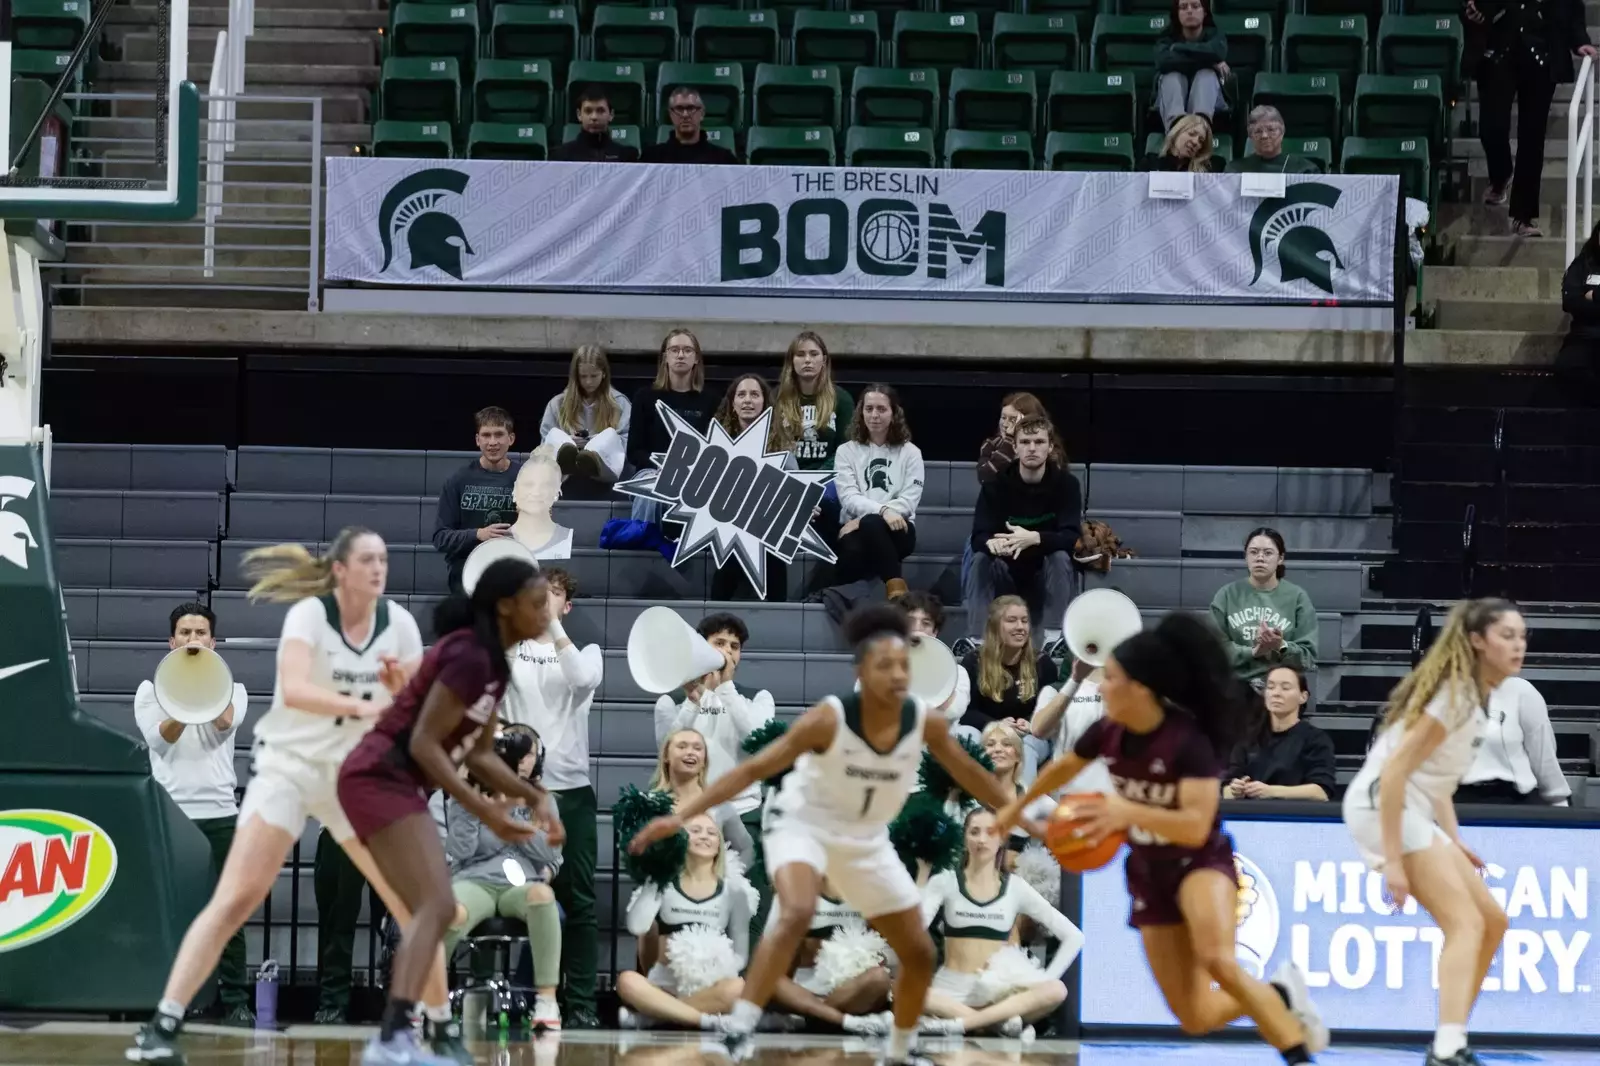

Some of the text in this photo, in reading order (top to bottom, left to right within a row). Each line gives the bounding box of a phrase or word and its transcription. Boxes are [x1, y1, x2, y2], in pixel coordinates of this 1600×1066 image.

[792, 172, 939, 195] THE BRESLIN
[721, 198, 1006, 287] BOOM
[795, 440, 828, 458] TATE
[460, 492, 514, 511] SPARTA
[652, 430, 826, 559] BOOM!
[1227, 606, 1291, 630] MICHIGAN
[859, 786, 876, 818] 1
[1291, 924, 1592, 993] LOTTRY
